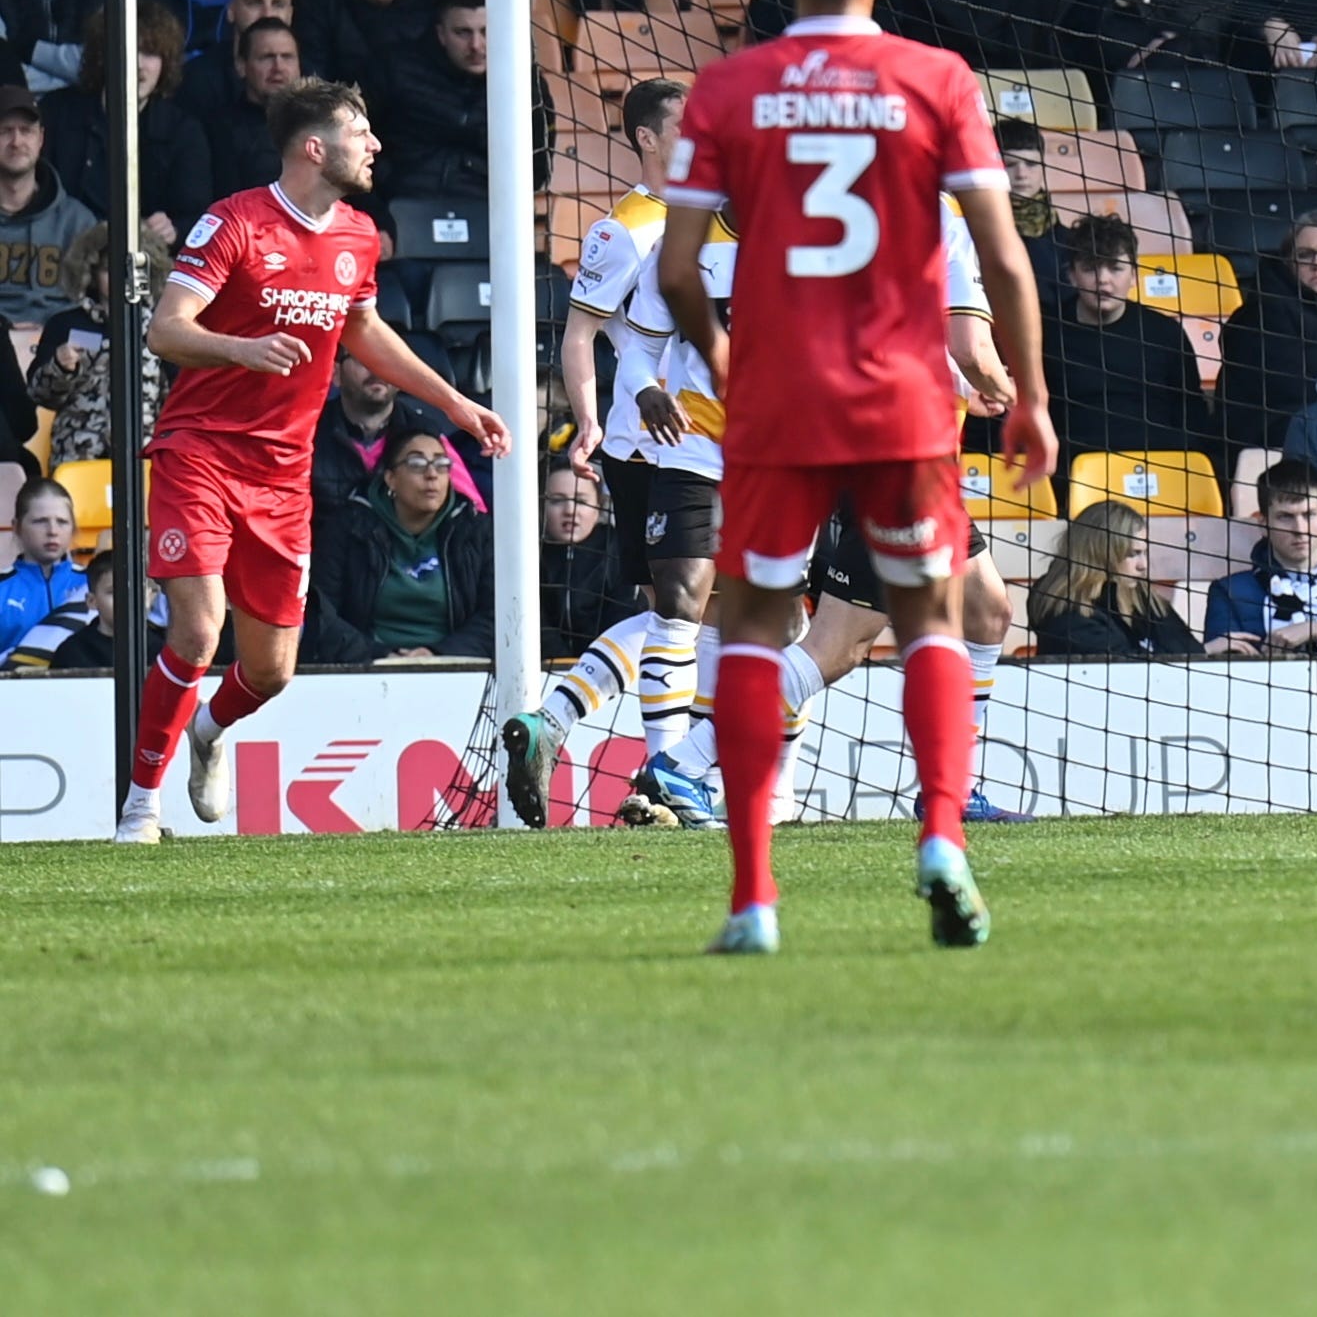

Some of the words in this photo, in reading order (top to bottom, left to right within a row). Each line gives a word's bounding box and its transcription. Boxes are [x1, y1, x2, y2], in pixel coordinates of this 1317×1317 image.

[753, 92, 906, 131] BENNING
[786, 133, 880, 277] 3
[260, 287, 351, 315] SHROPSHIRE
[274, 306, 336, 331] HOMES
